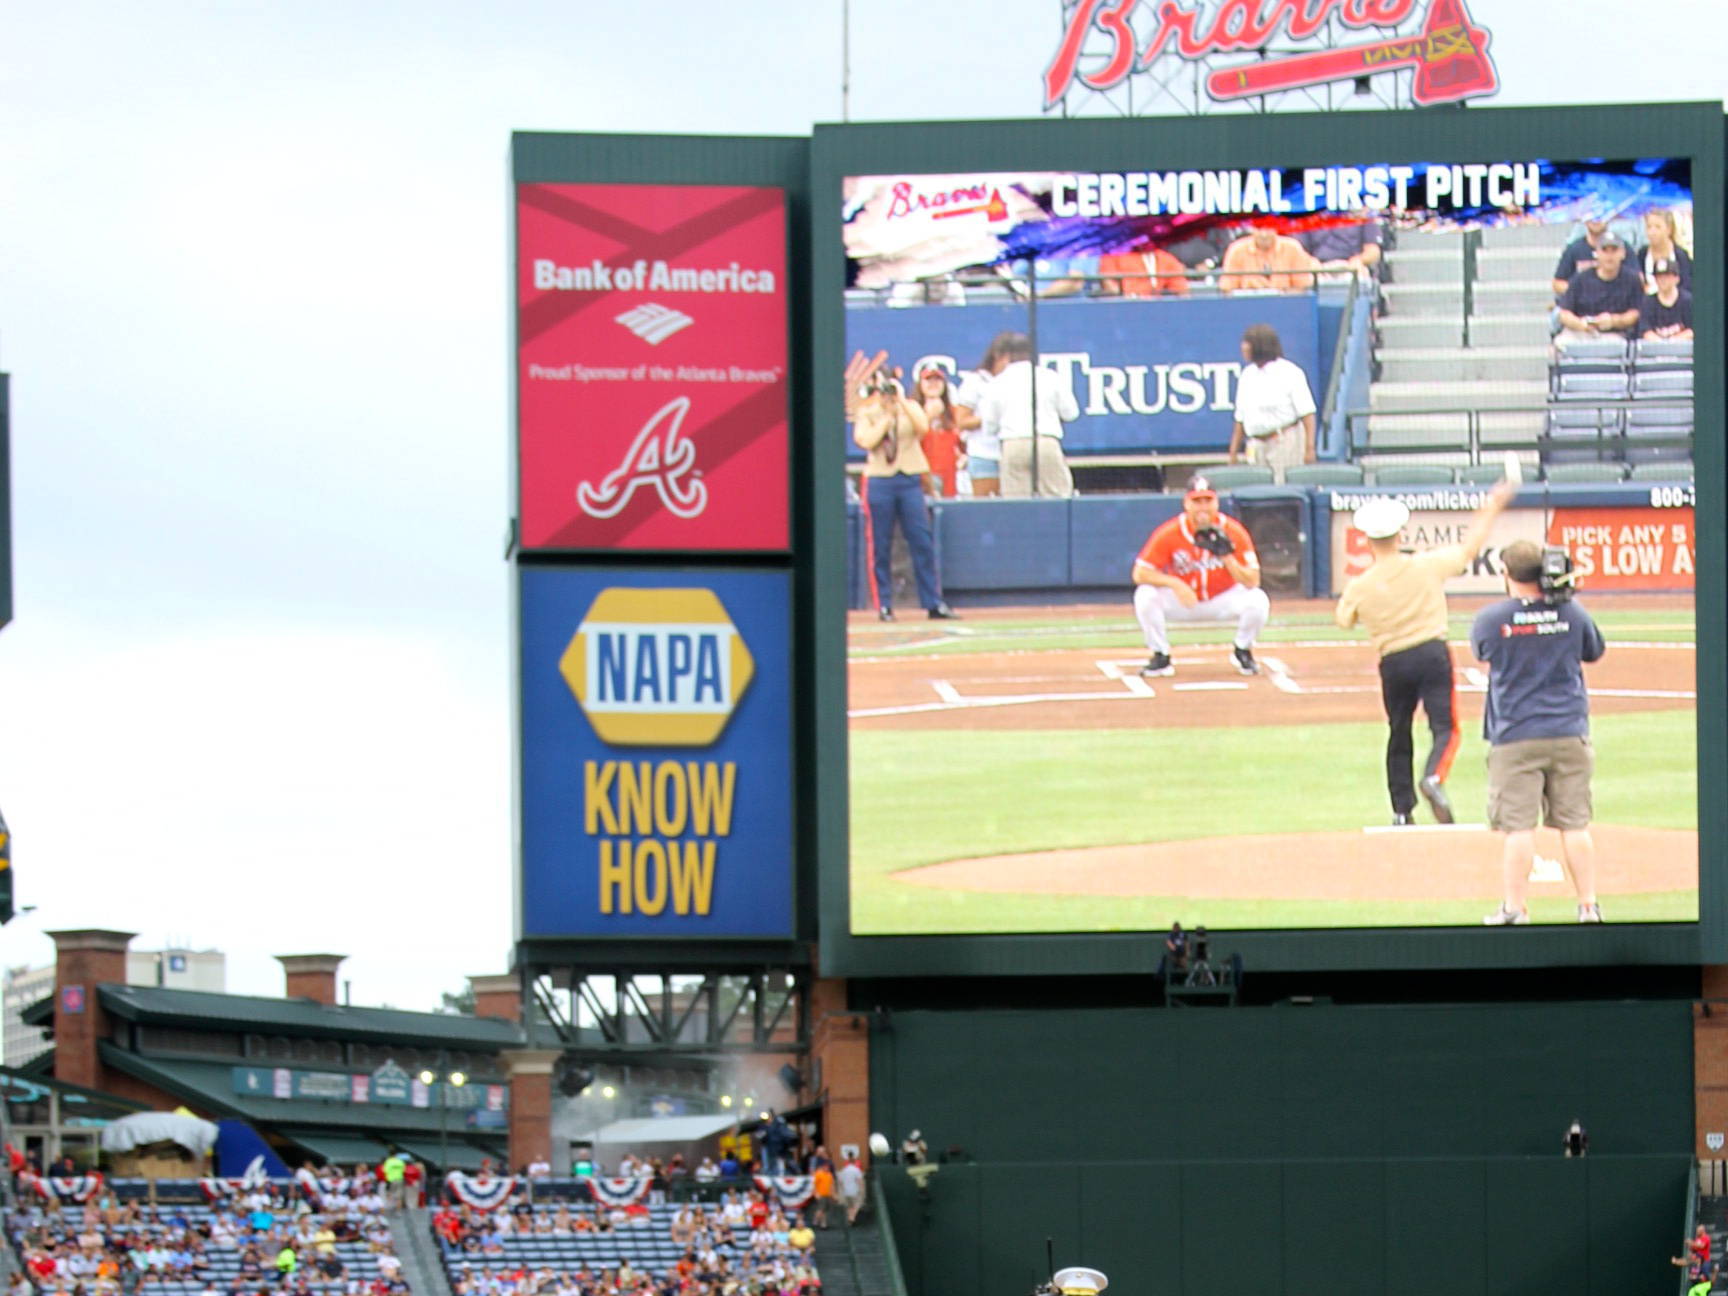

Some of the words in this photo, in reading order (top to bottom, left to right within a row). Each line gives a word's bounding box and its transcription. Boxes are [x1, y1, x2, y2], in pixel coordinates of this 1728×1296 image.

[1051, 170, 1292, 218] CEREMONIAL
[1303, 165, 1414, 212] FIRST
[1426, 162, 1541, 210] PITCH
[533, 258, 613, 291] Bank
[614, 259, 647, 291] of
[650, 260, 775, 294] America
[1562, 524, 1613, 545] PICK
[1618, 524, 1665, 545] ANY
[1601, 544, 1665, 576] LOW
[596, 632, 724, 703] NAPA
[583, 759, 736, 837] KNOW
[598, 838, 717, 916] HOW
